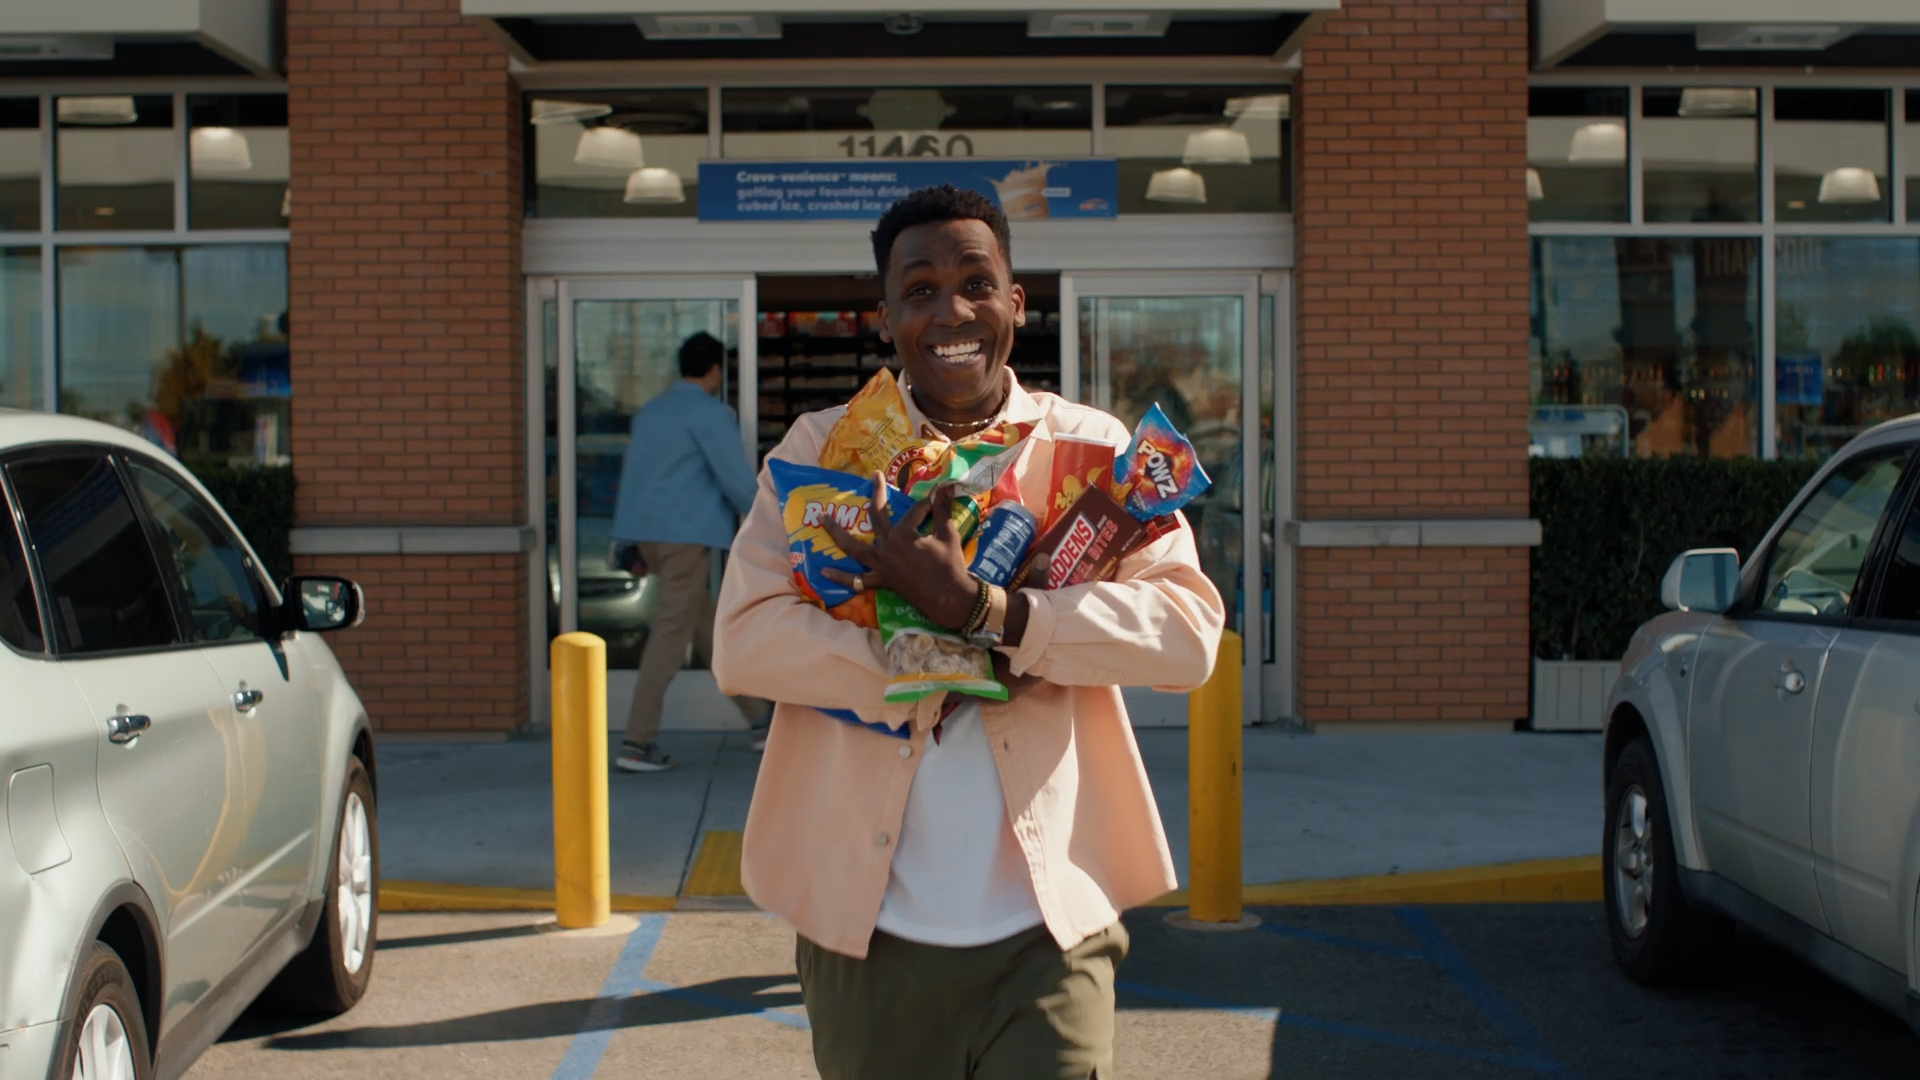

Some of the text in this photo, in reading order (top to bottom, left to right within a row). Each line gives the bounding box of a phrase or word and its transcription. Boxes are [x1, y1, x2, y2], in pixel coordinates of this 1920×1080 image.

[838, 134, 974, 157] 11460
[849, 172, 897, 182] means:
[737, 186, 784, 201] getting
[787, 189, 817, 200] your
[818, 186, 875, 198] fountain
[737, 200, 778, 211] cubed
[807, 200, 860, 211] crushed
[862, 200, 881, 211] ice
[887, 448, 920, 482] CHIPS
[1137, 439, 1179, 499] POWZ
[1047, 518, 1093, 590] ADDENS
[1066, 519, 1119, 586] MEL BITES
